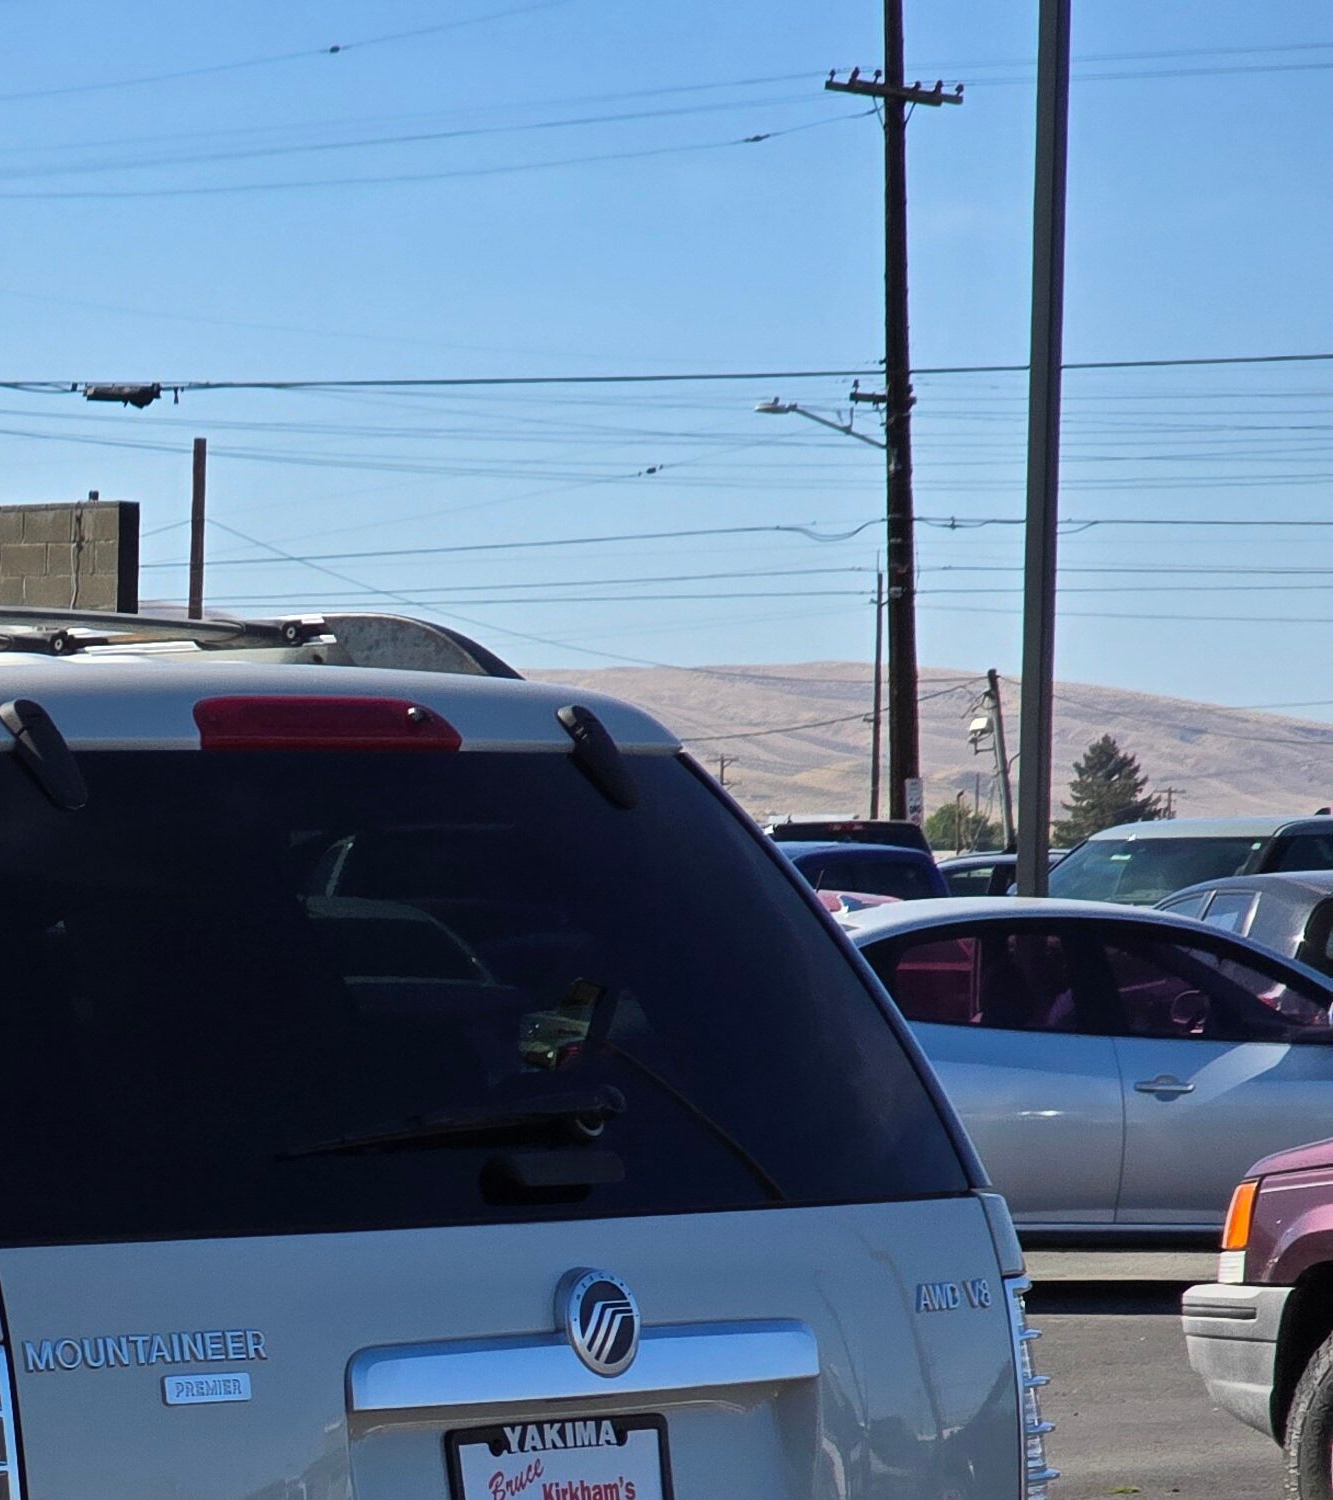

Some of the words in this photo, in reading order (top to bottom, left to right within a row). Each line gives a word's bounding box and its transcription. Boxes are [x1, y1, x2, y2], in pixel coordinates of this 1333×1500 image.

[916, 1283, 961, 1313] AWD
[962, 1279, 992, 1309] V8
[23, 1329, 268, 1372] MOUNTAINEER
[174, 1379, 242, 1398] PREMIER
[504, 1421, 617, 1452] YAKIMA
